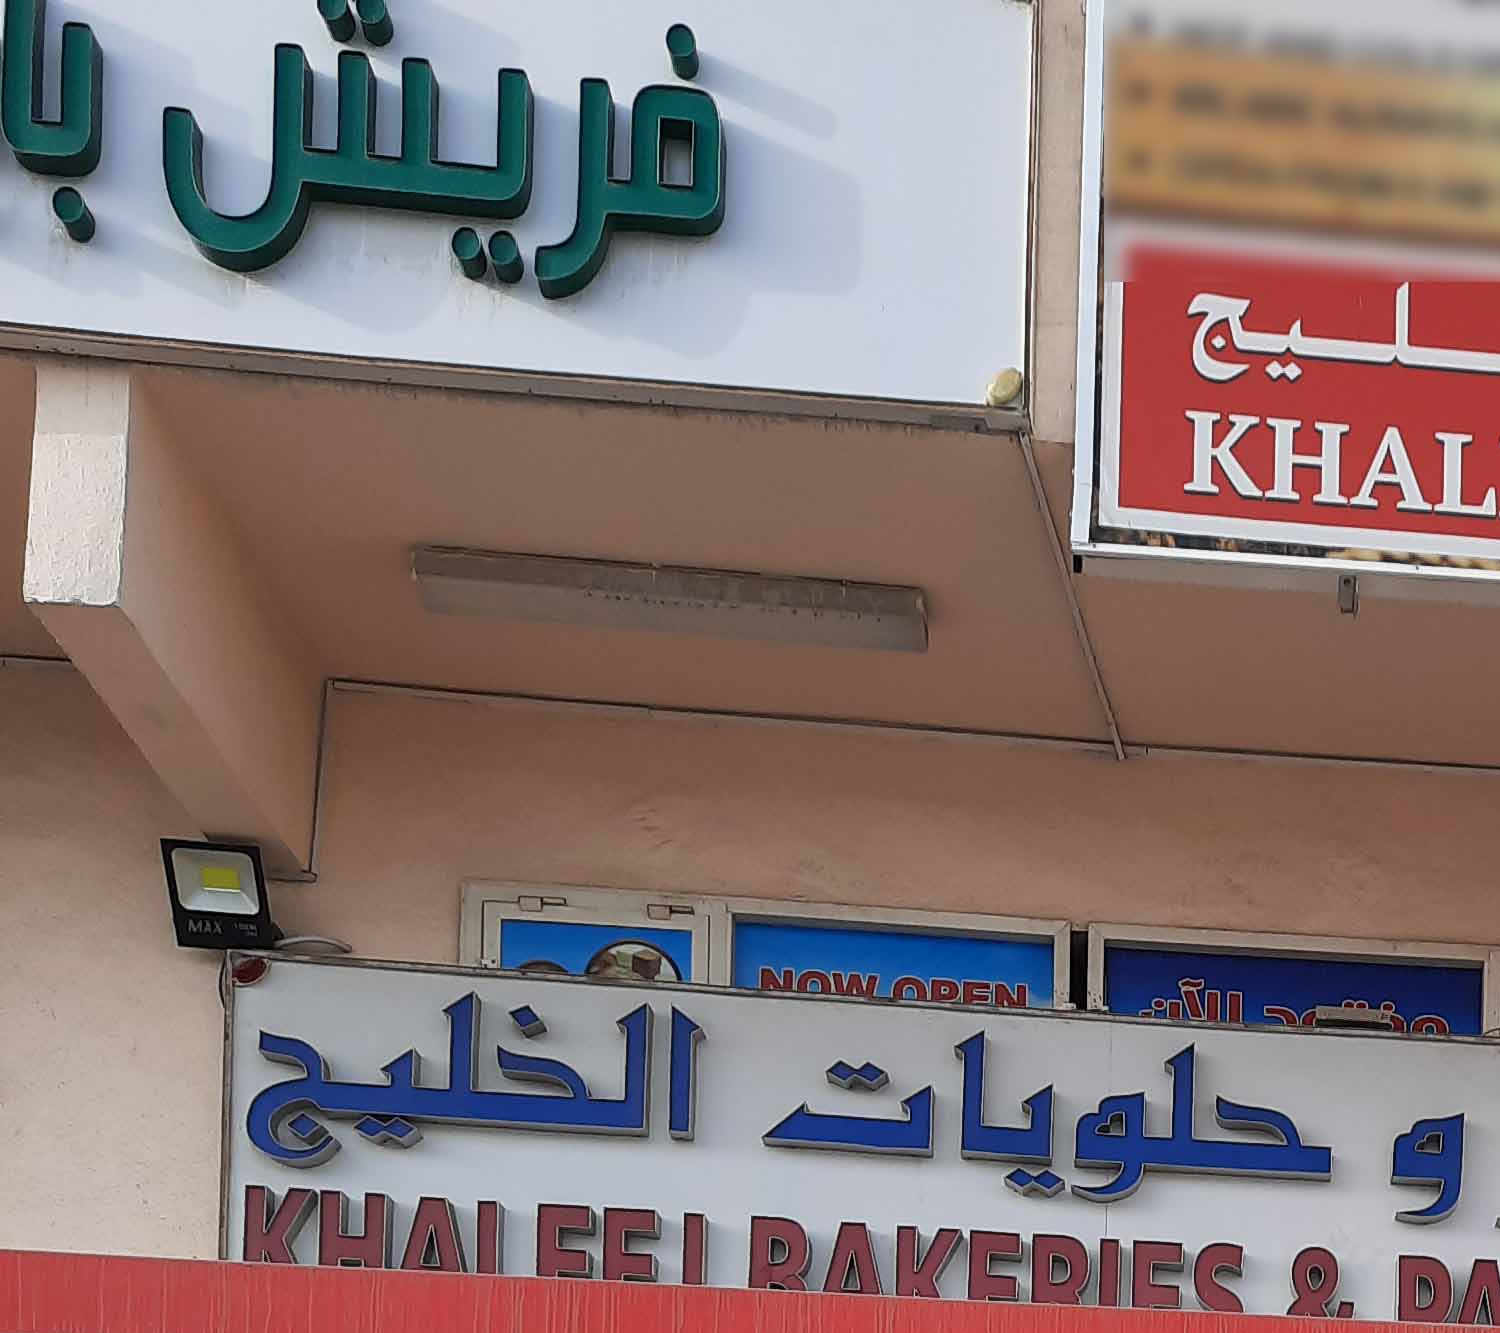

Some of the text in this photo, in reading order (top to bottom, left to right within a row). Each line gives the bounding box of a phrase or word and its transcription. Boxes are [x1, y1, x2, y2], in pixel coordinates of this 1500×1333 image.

[246, 990, 706, 1168] الخليج
[762, 1030, 1334, 1203] حلويات
[1291, 1246, 1355, 1319] &
